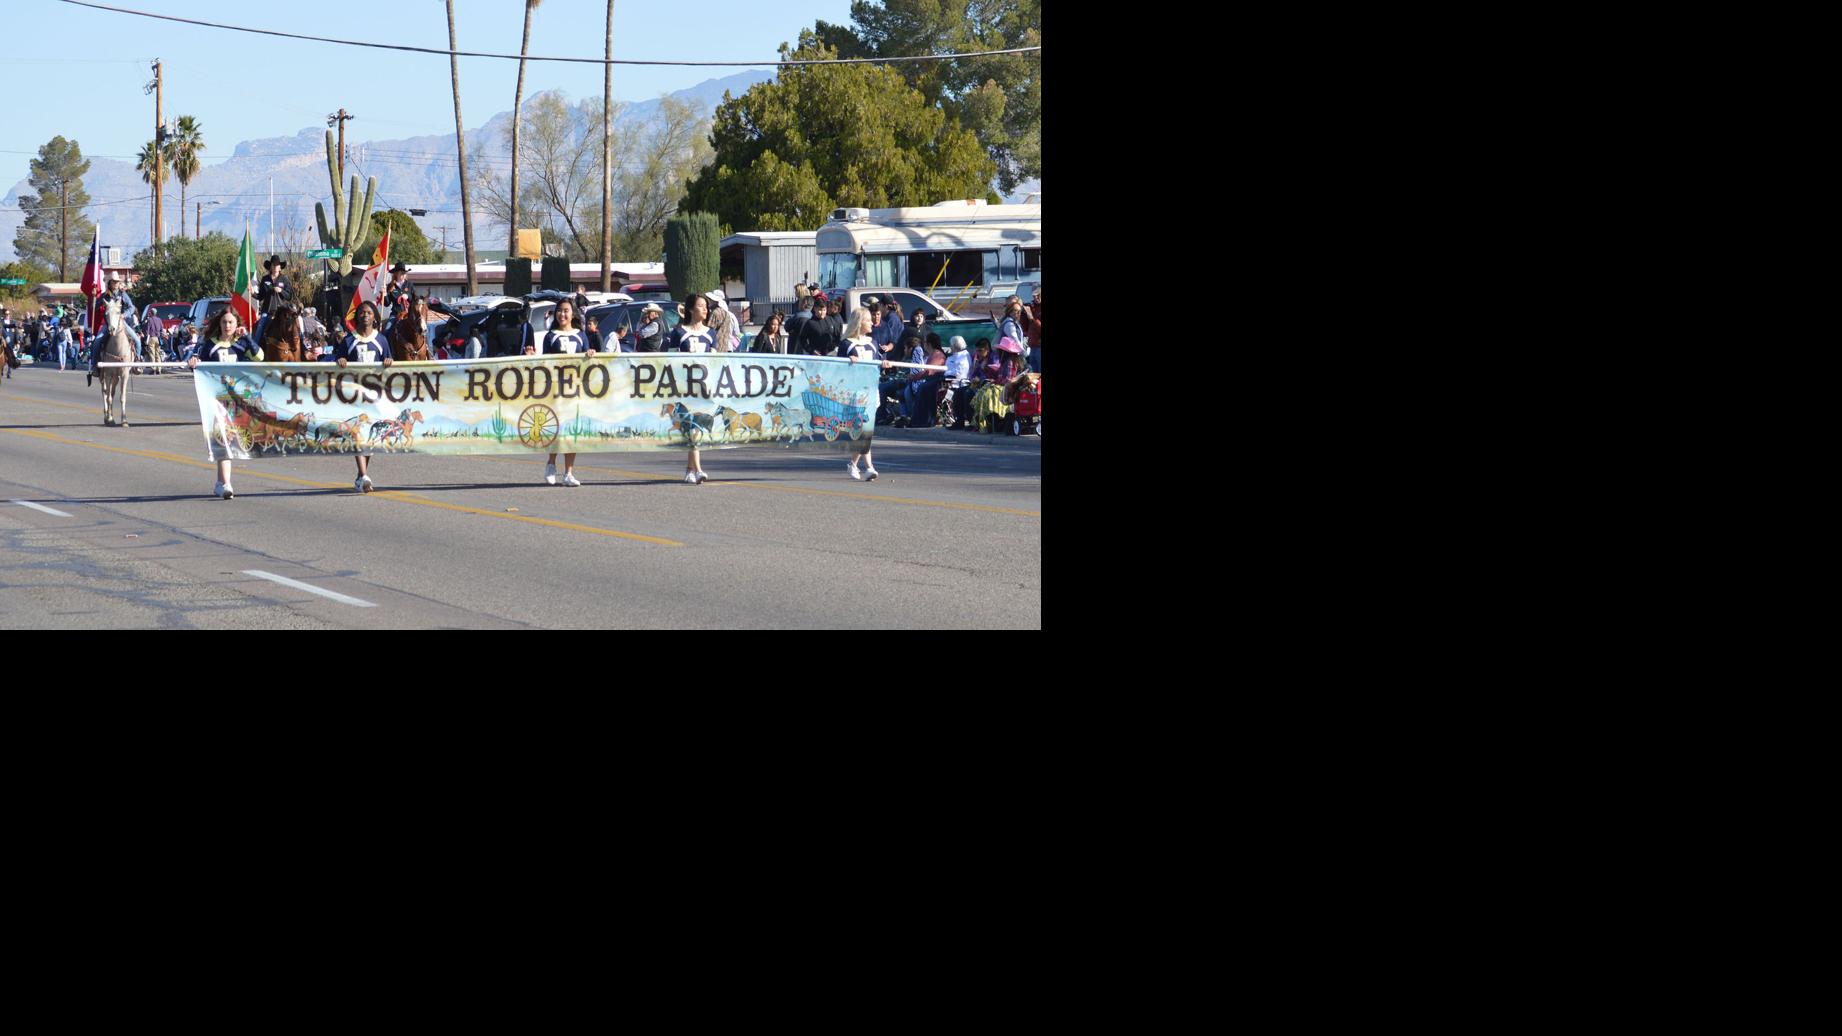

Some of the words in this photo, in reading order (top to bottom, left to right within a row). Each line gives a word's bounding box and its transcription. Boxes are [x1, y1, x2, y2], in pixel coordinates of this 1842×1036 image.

[281, 370, 445, 404] TUCSON
[463, 364, 611, 401] RODEO
[629, 363, 795, 399] PARADE
